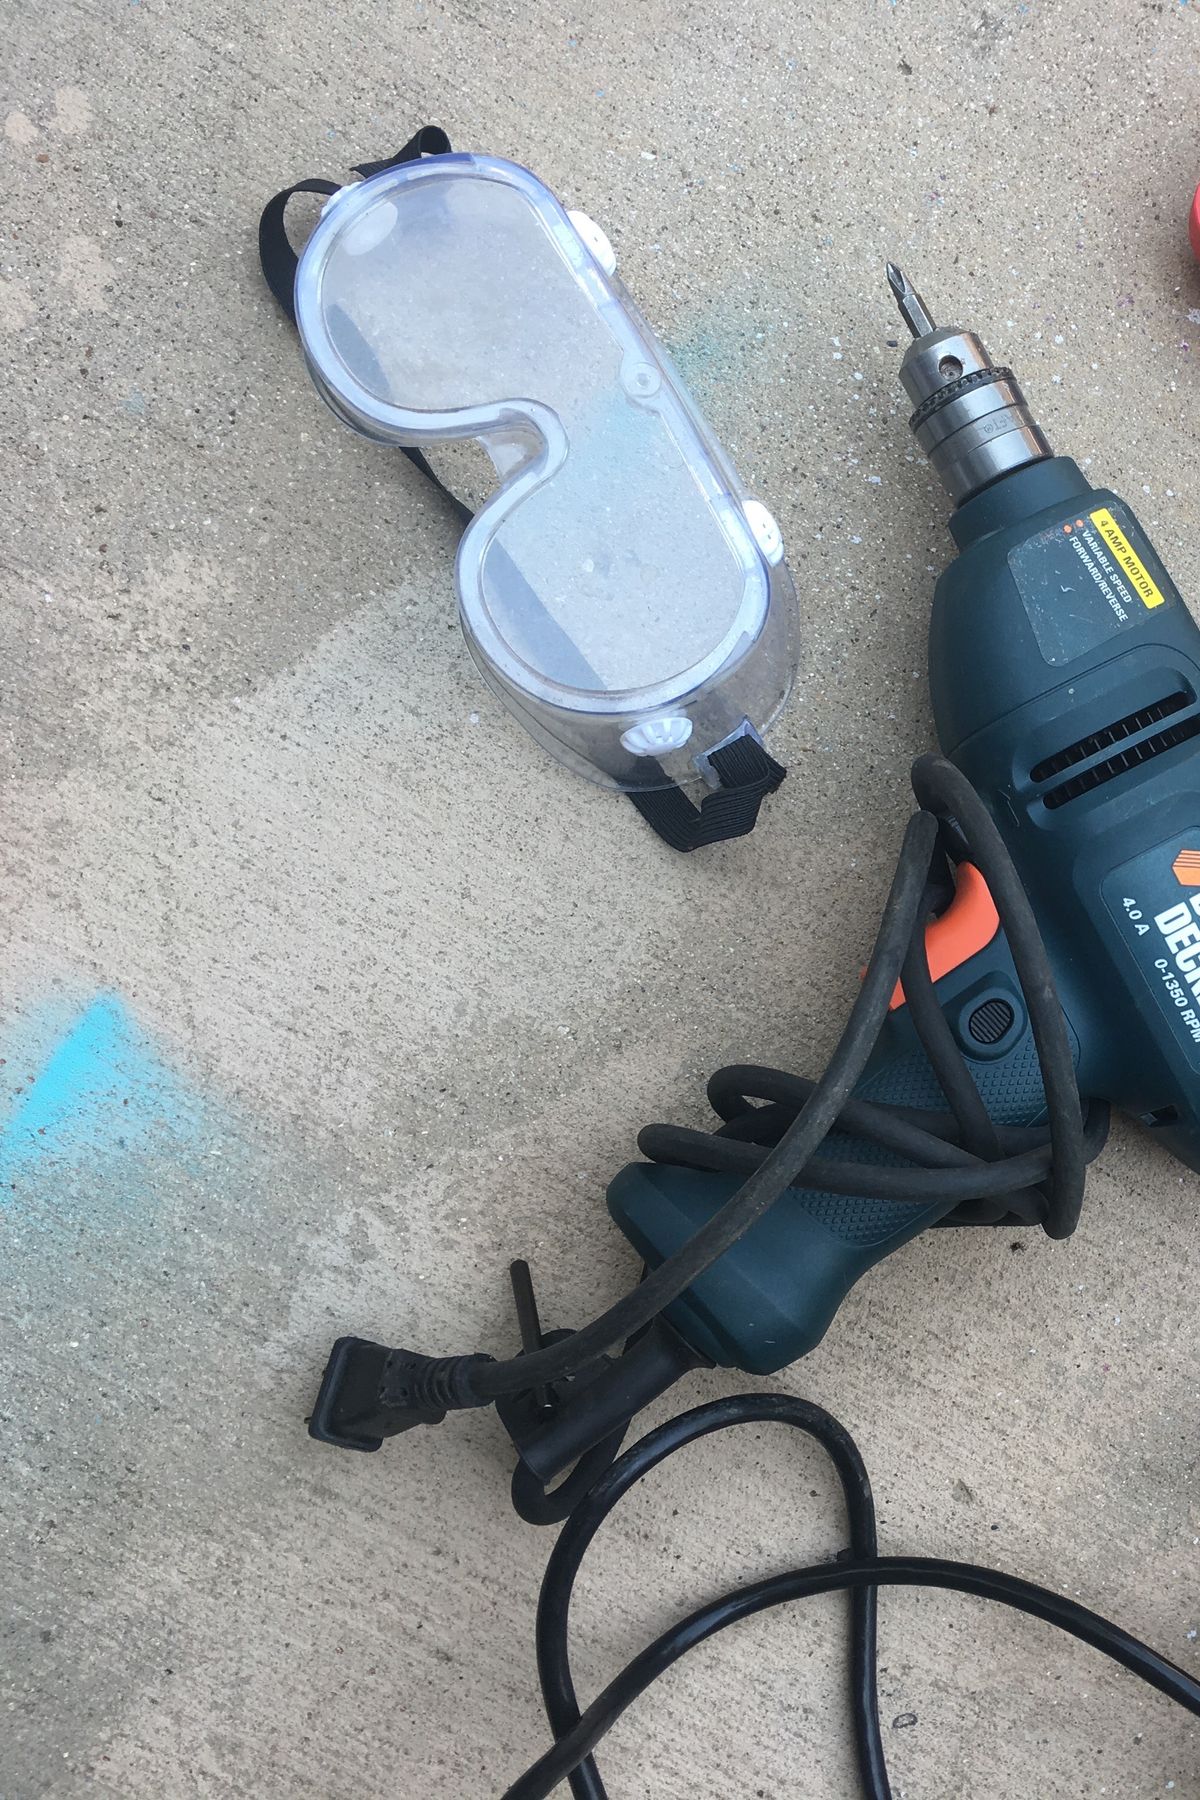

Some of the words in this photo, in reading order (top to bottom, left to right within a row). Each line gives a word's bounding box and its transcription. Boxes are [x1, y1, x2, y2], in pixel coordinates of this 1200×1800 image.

[1069, 536, 1129, 622] FORWARD/REVERSE
[1082, 530, 1114, 574] VARIABLE
[1110, 573, 1133, 603] SPEED
[1105, 529, 1127, 555] AMP
[1123, 556, 1154, 598] MOTOR
[1123, 897, 1142, 920] 4.0
[1134, 924, 1150, 936] A
[1154, 958, 1188, 1008] 0-1350
